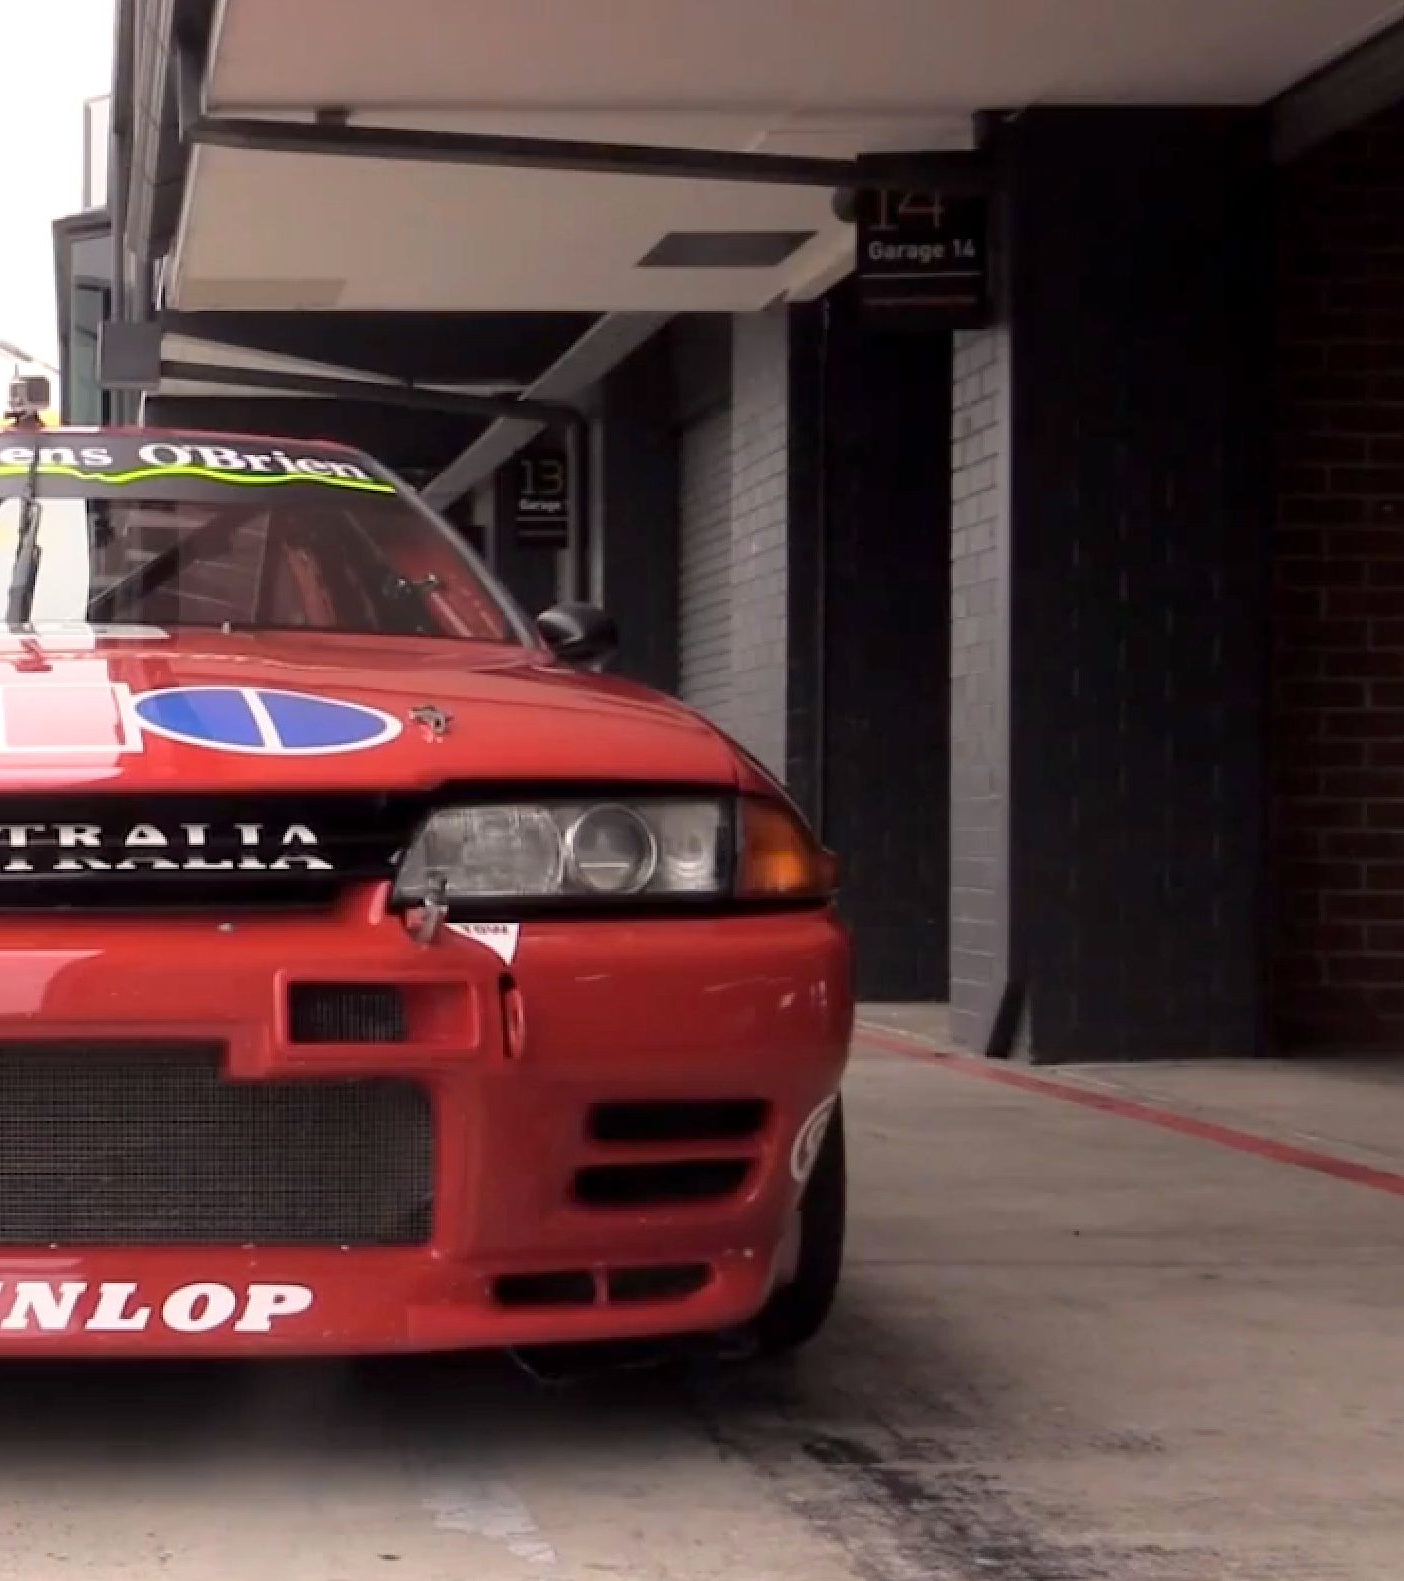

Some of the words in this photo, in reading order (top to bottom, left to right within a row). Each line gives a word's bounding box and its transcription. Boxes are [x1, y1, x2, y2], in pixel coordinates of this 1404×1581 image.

[868, 189, 944, 231] 14
[867, 240, 944, 263] Garage
[952, 238, 976, 258] 14
[139, 442, 373, 480] O'Brien
[519, 459, 564, 495] 13
[519, 498, 562, 513] Garage
